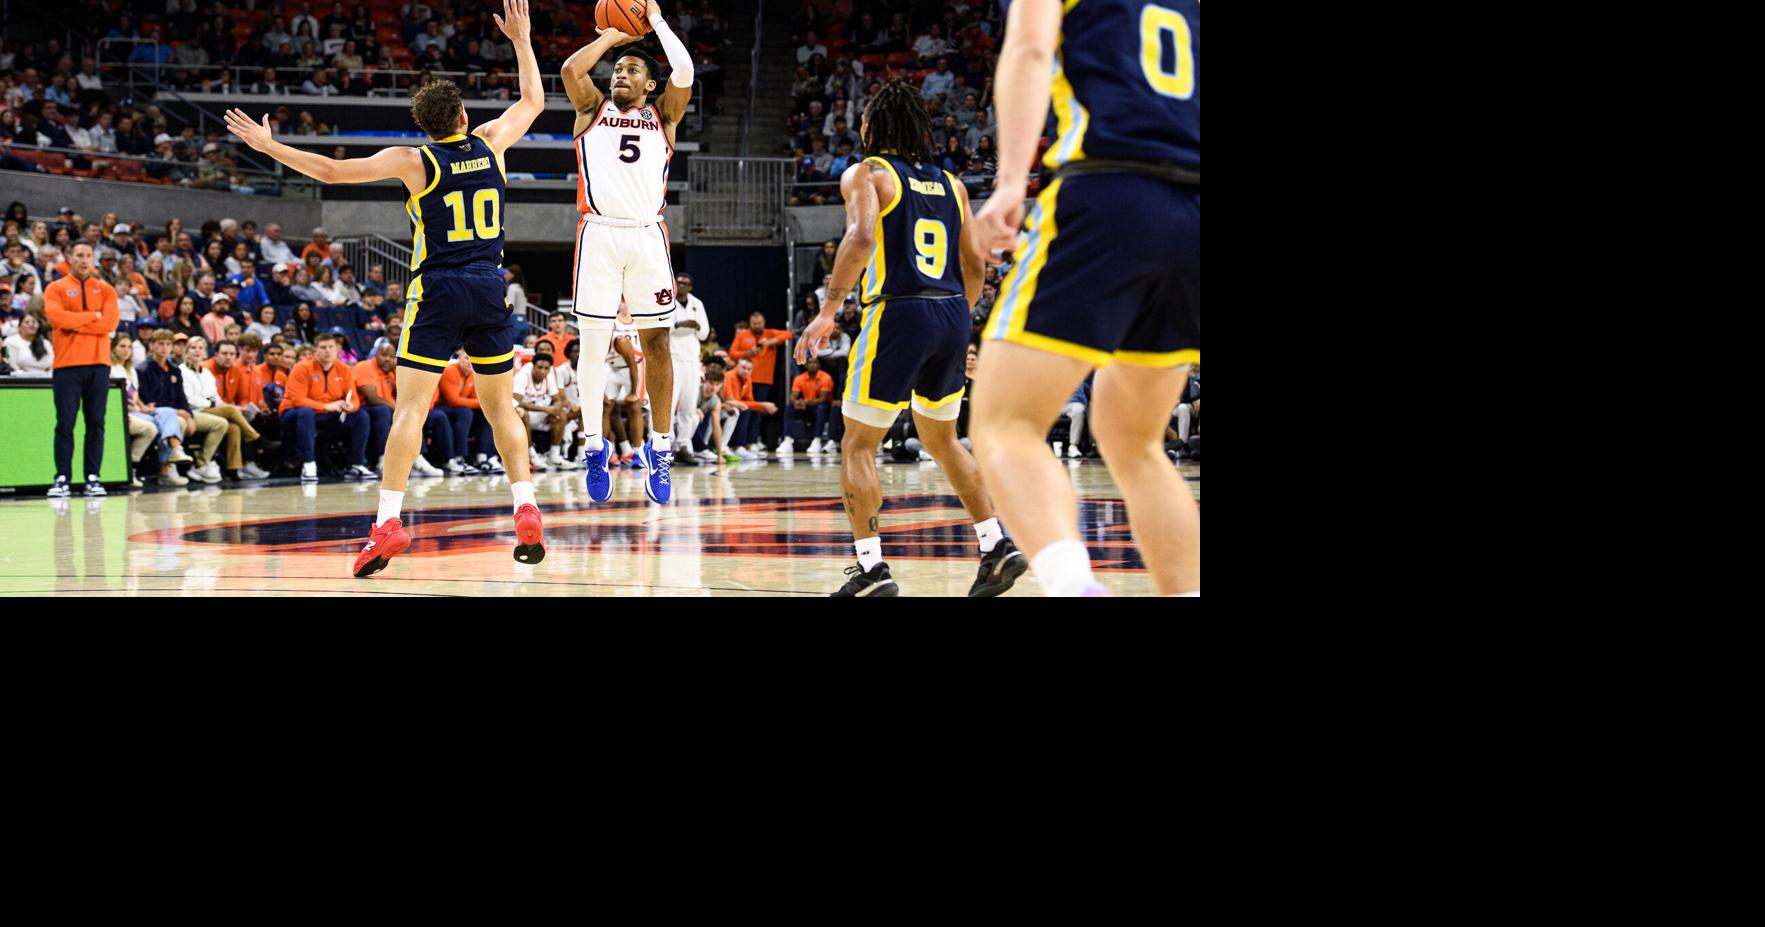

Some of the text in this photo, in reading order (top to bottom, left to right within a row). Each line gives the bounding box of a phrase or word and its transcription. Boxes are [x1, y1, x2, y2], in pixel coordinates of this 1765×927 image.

[1140, 4, 1194, 99] 0
[598, 117, 659, 131] AUBURN
[619, 135, 641, 163] 5
[443, 188, 500, 242] 10
[914, 218, 948, 279] 9
